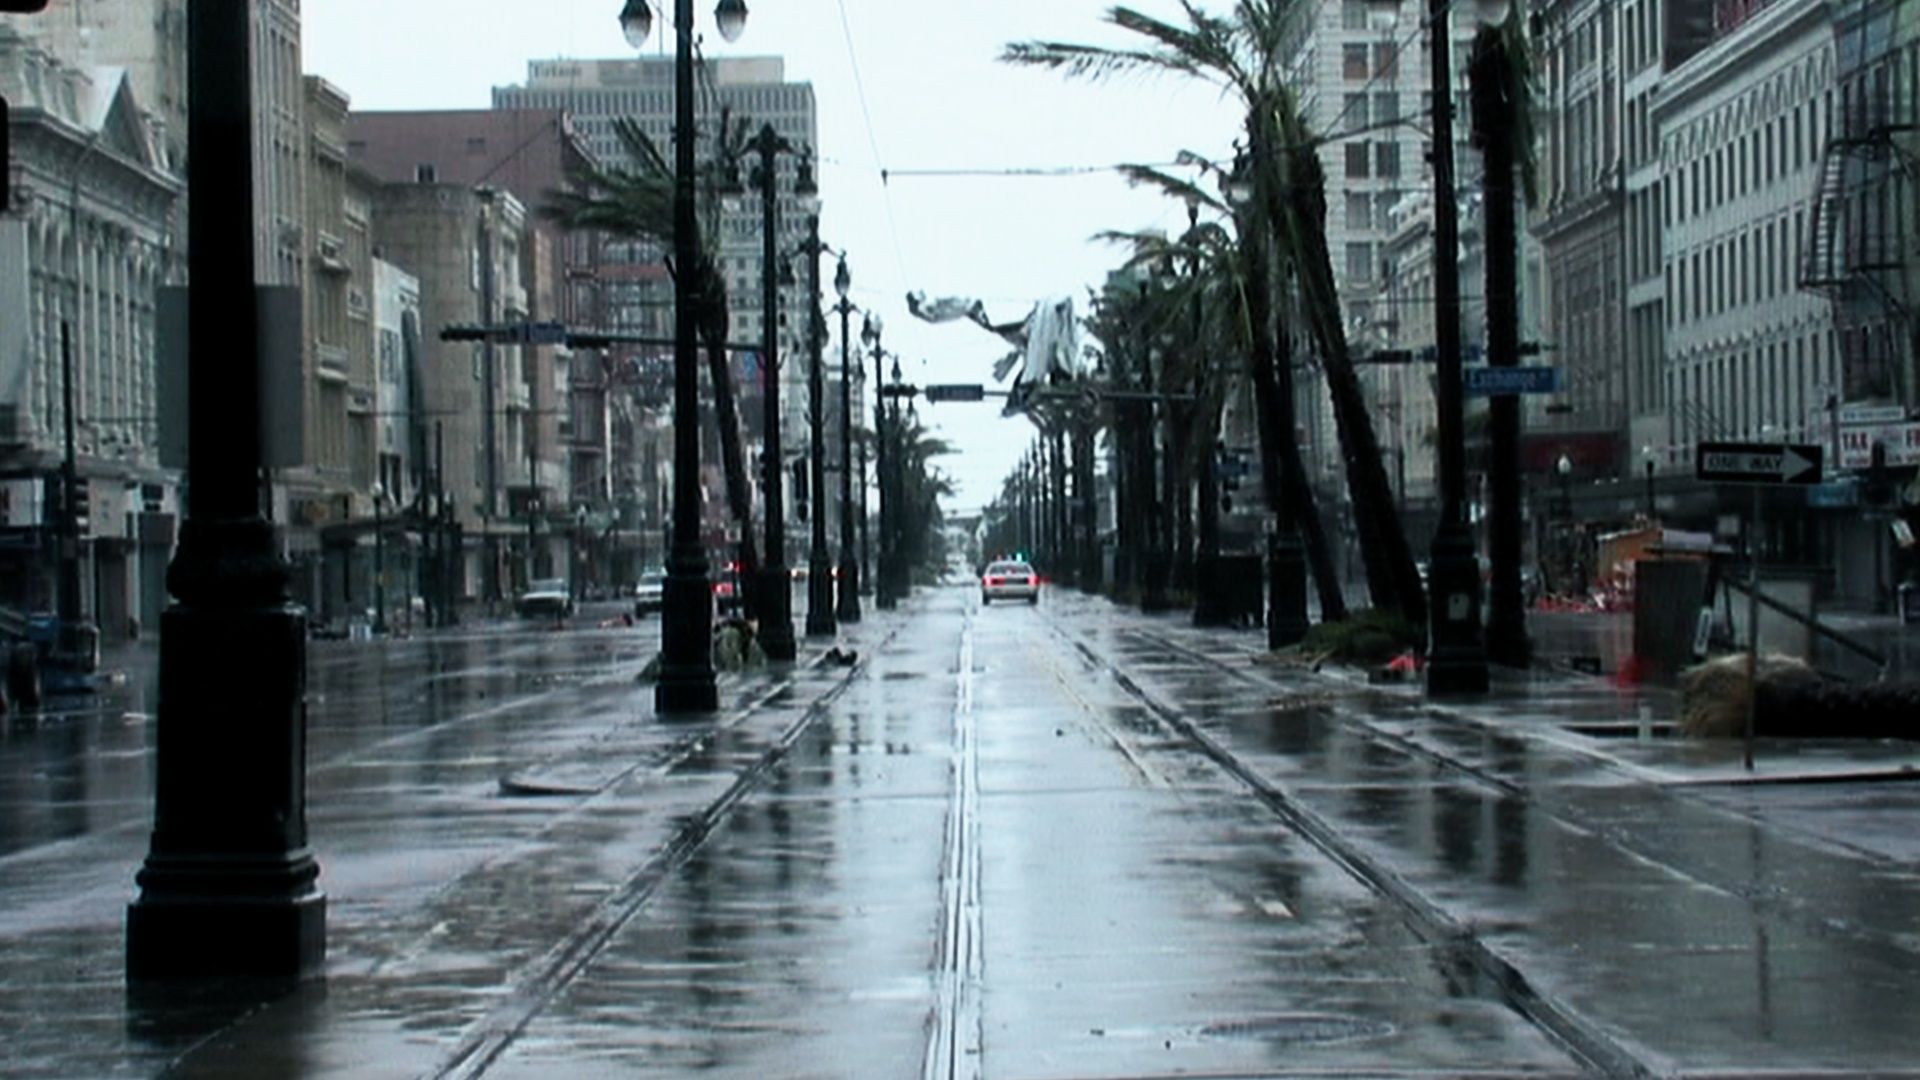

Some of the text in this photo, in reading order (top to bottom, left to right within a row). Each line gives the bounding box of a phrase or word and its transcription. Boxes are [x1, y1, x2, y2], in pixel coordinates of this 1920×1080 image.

[1842, 431, 1869, 450] TAX
[1708, 455, 1782, 470] ONE WAY
